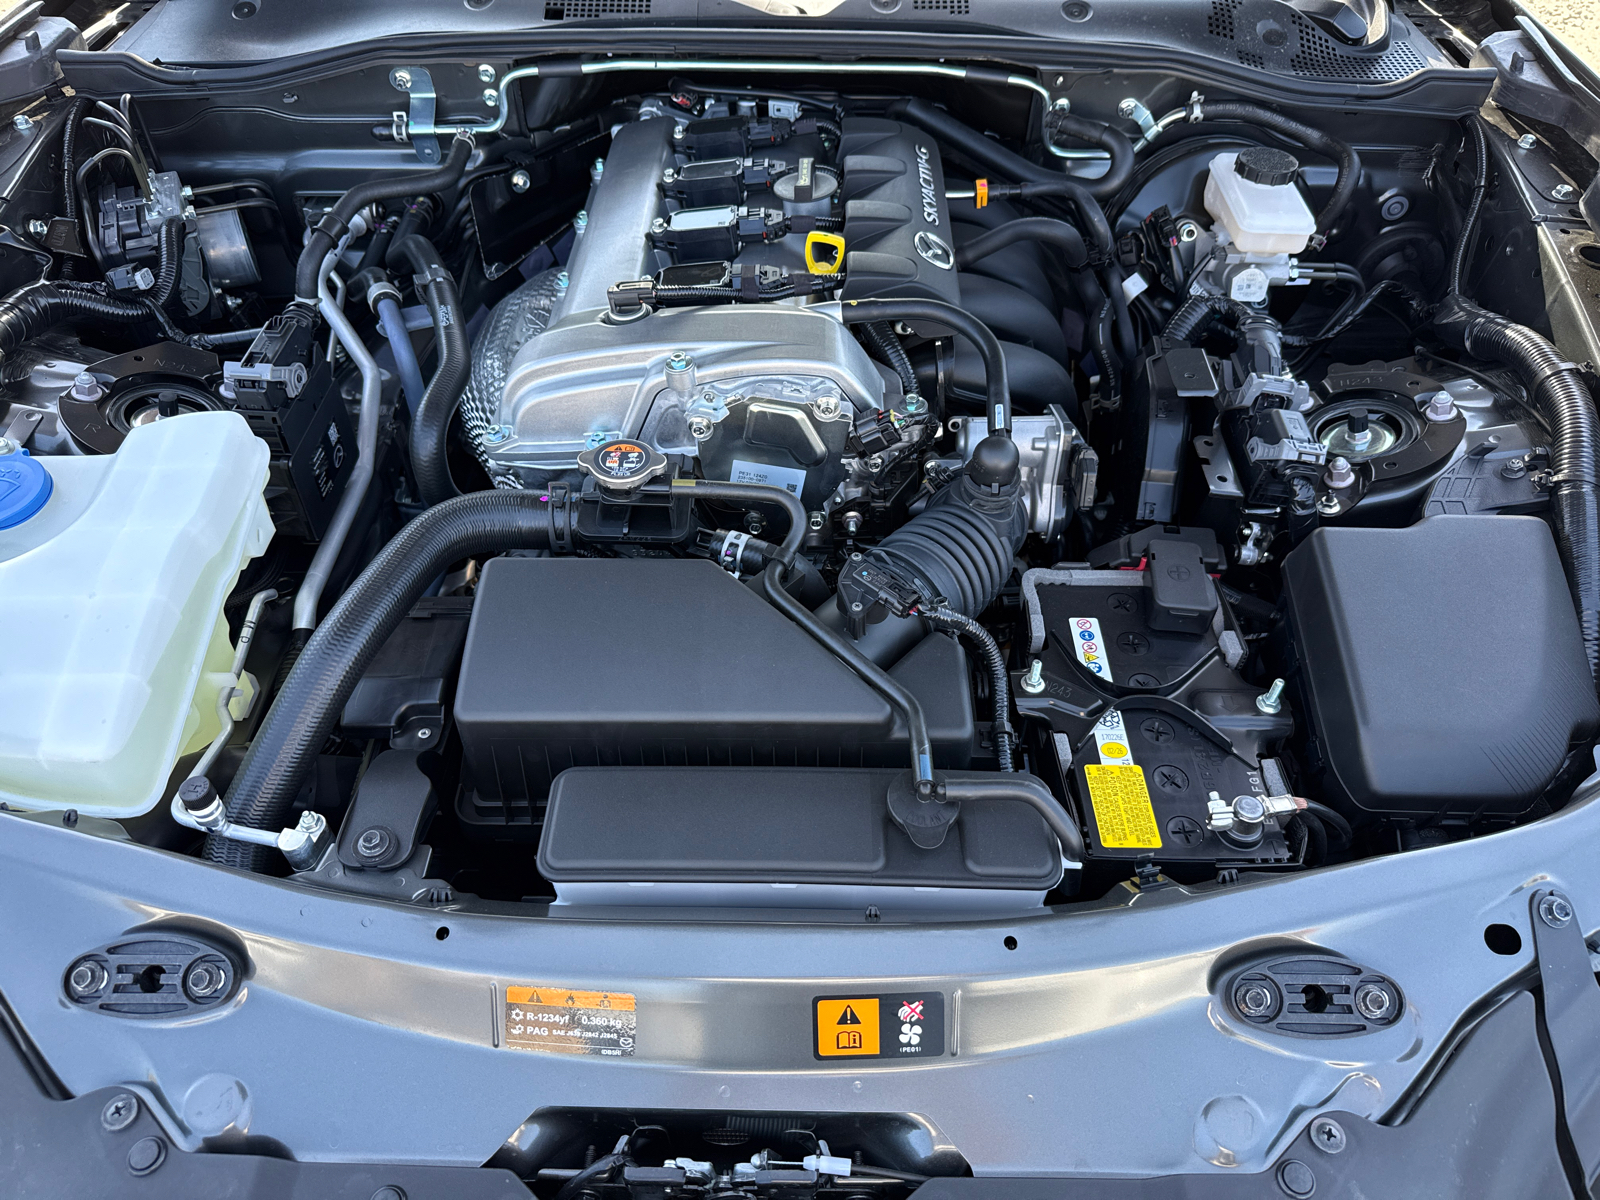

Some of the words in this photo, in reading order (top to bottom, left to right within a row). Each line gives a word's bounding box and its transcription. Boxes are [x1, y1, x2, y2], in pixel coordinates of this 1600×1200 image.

[915, 144, 939, 226] SKYACTIV-G
[1046, 681, 1072, 699] N243
[1107, 747, 1124, 755] 02/26
[1107, 776, 1119, 796] POISON
[1136, 778, 1148, 803] DANGER
[526, 1012, 570, 1025] R-1234yf
[581, 1015, 607, 1025] 0.360
[609, 1017, 622, 1028] kg
[526, 1026, 549, 1036] PAG
